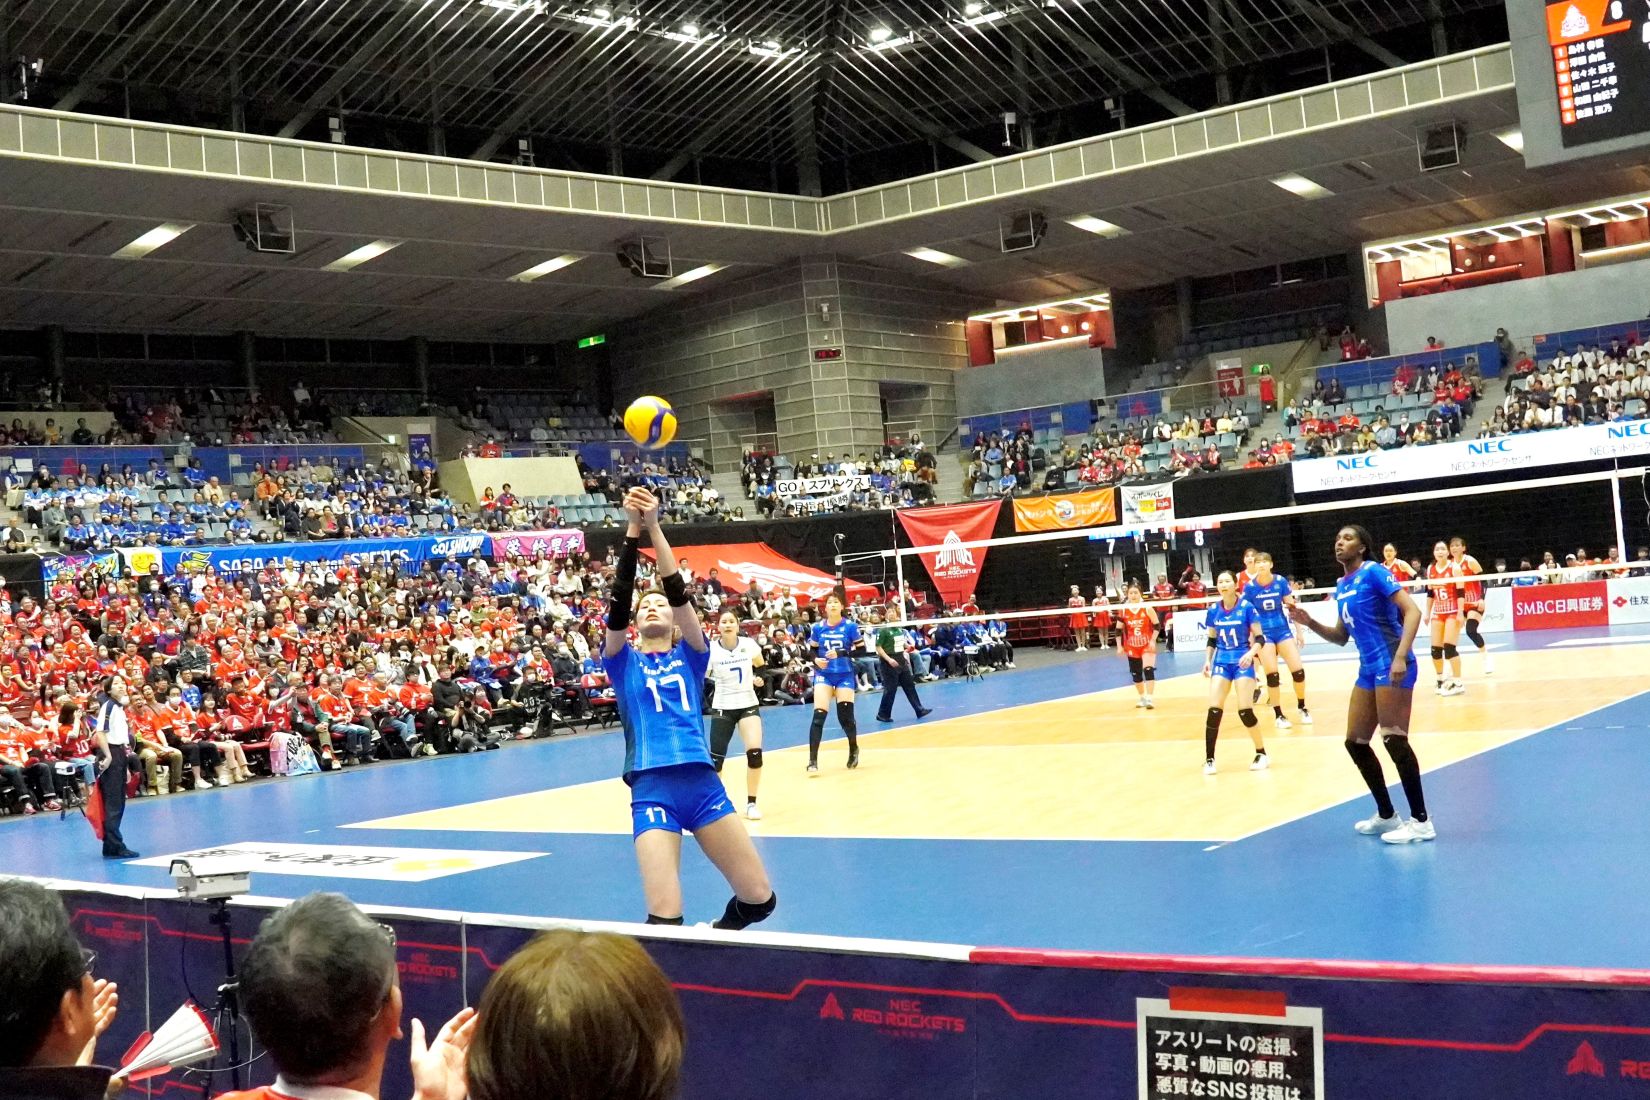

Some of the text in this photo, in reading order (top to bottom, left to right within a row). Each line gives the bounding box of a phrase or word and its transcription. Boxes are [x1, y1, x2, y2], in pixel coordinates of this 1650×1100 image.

[1608, 423, 1650, 439] NEC
[1468, 439, 1512, 455] NEC
[1337, 455, 1378, 470] NEC
[1194, 530, 1204, 546] 8
[1106, 539, 1116, 554] 7
[1434, 588, 1448, 600] 16
[1516, 596, 1604, 616] SMBC日興証券
[1342, 602, 1355, 628] 4
[1134, 628, 1141, 636] 6
[1220, 628, 1239, 649] 11
[730, 667, 742, 683] 7
[646, 674, 690, 712] 17
[76, 740, 89, 754] 10
[645, 807, 667, 823] 17
[890, 1000, 921, 1012] NEC
[852, 1008, 966, 1033] RED ROCKETS
[1155, 1030, 1298, 1057] アスリートの盗撮、
[1155, 1052, 1292, 1080] 写真・動画の悪用、
[1156, 1075, 1300, 1100] 悪質なSNS投稿は
